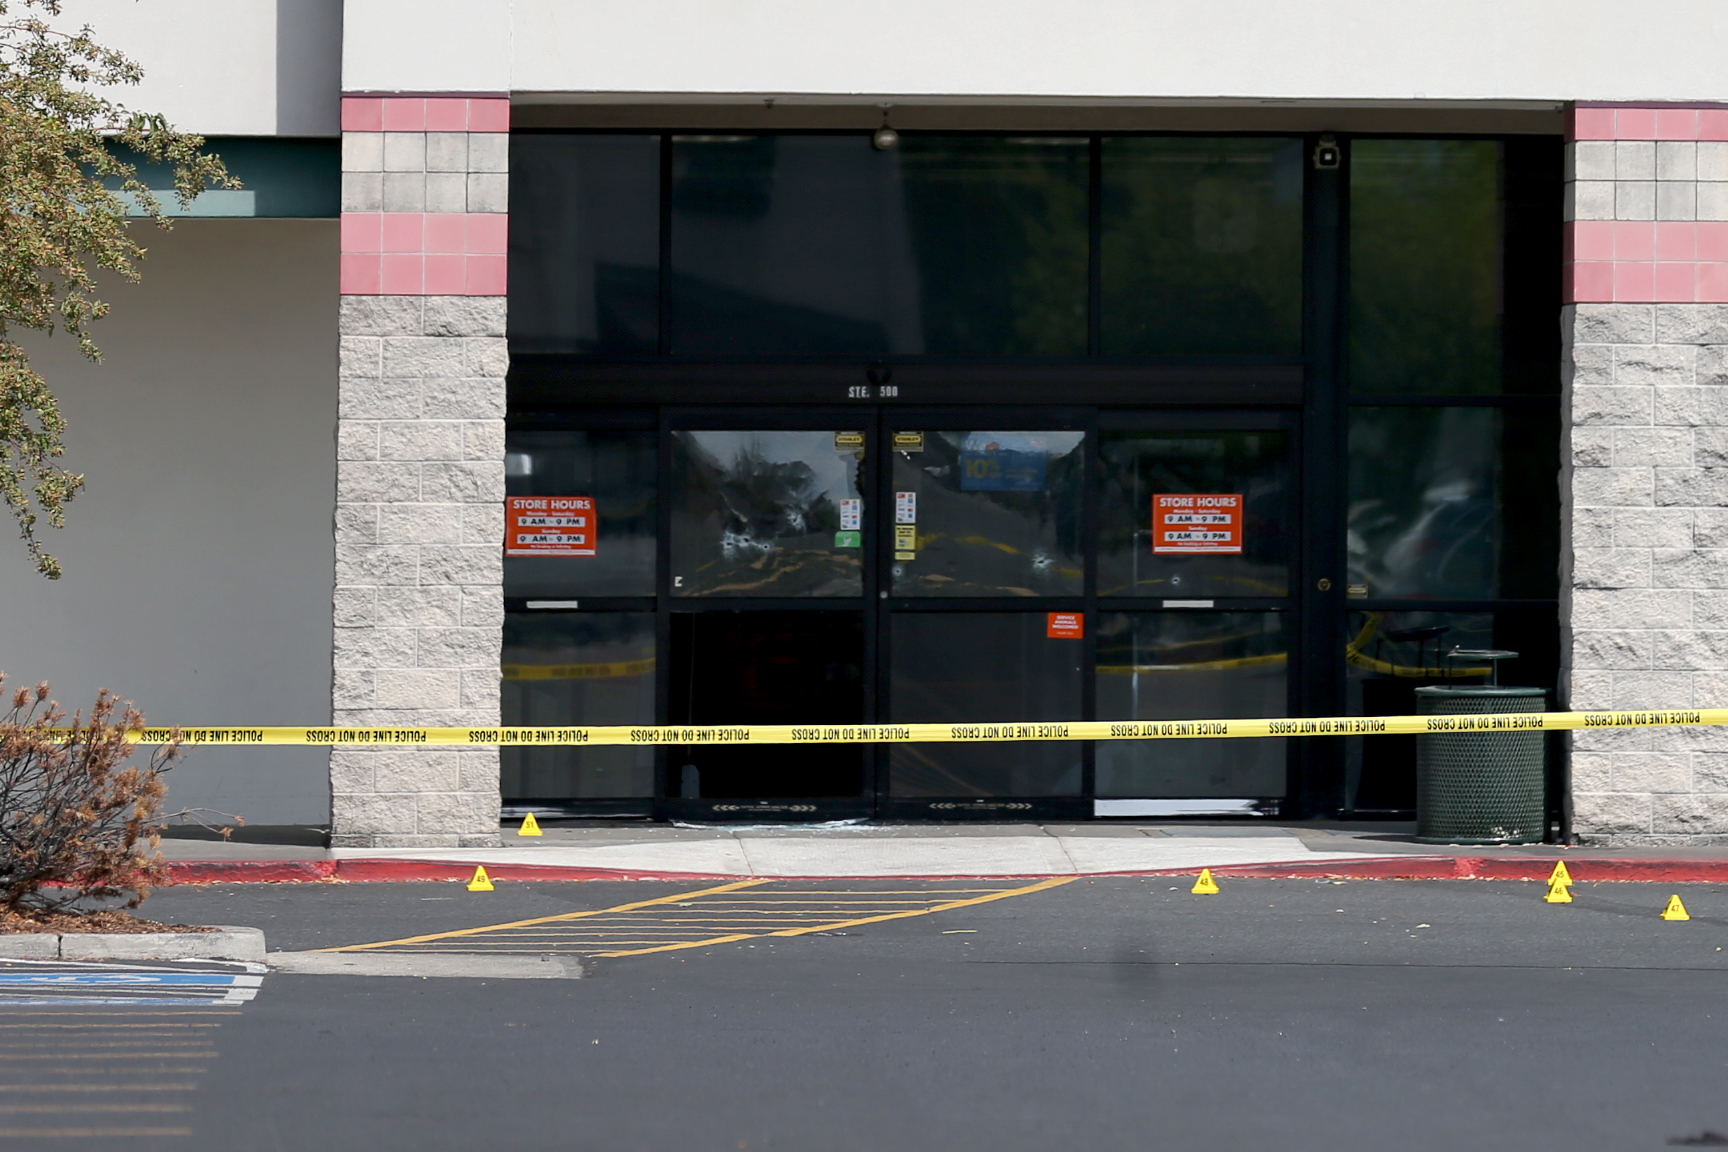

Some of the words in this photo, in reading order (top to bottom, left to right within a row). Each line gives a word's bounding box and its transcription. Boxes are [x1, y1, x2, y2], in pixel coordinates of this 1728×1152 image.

[880, 386, 898, 397] 500
[513, 499, 548, 509] STORE
[550, 500, 591, 510] HOURS
[1160, 497, 1194, 507] STORE
[1197, 497, 1237, 507] HOURS
[1168, 532, 1174, 540] 9
[1427, 719, 1456, 731] CROSS
[1457, 718, 1475, 730] NOT
[1477, 718, 1489, 730] DO
[1491, 717, 1511, 730] LINE
[1512, 716, 1543, 729] POLICE
[1584, 715, 1613, 727] CROSS
[1615, 714, 1633, 727] NOT
[1635, 714, 1647, 727] DO
[1649, 713, 1668, 726] LINE
[1670, 712, 1701, 725] POLICE
[982, 727, 999, 739] NOT
[1002, 727, 1014, 739] DO
[1016, 726, 1036, 739] LINE
[1038, 726, 1069, 738] POLICE
[1110, 725, 1139, 737] CROSS
[1141, 724, 1159, 737] NOT
[1161, 724, 1173, 737] DO
[1175, 724, 1195, 736] LINE
[1197, 723, 1228, 736] POLICE
[1269, 722, 1298, 734] CROSS
[1299, 722, 1317, 734] NOT
[1319, 722, 1332, 734] DO
[1334, 721, 1353, 733] LINE
[1355, 720, 1386, 733] POLICE
[141, 729, 172, 742] CROSS
[209, 729, 230, 742] LINE
[231, 729, 263, 742] POLICE
[306, 729, 336, 742] CROSS
[339, 729, 356, 742] NOT
[358, 729, 371, 742] DO
[373, 729, 393, 742] LINE
[394, 729, 427, 742] POLICE
[468, 729, 498, 742] CROSS
[501, 729, 518, 742] NOT
[520, 729, 533, 742] DO
[535, 729, 555, 742] LINE
[557, 729, 589, 742] POLICE
[630, 729, 660, 742] CROSS
[662, 729, 679, 742] NOT
[681, 729, 694, 742] DO
[696, 729, 716, 742] LINE
[718, 729, 750, 741] POLICE
[791, 729, 820, 741] CROSS
[822, 728, 840, 741] NOT
[842, 728, 854, 740] DO
[857, 728, 876, 740] LINE
[879, 728, 910, 740] POLICE
[951, 728, 980, 740] CROSS
[476, 875, 486, 884] 49
[1200, 878, 1209, 886] 48
[1554, 886, 1564, 895] 46
[1670, 904, 1680, 913] 47
